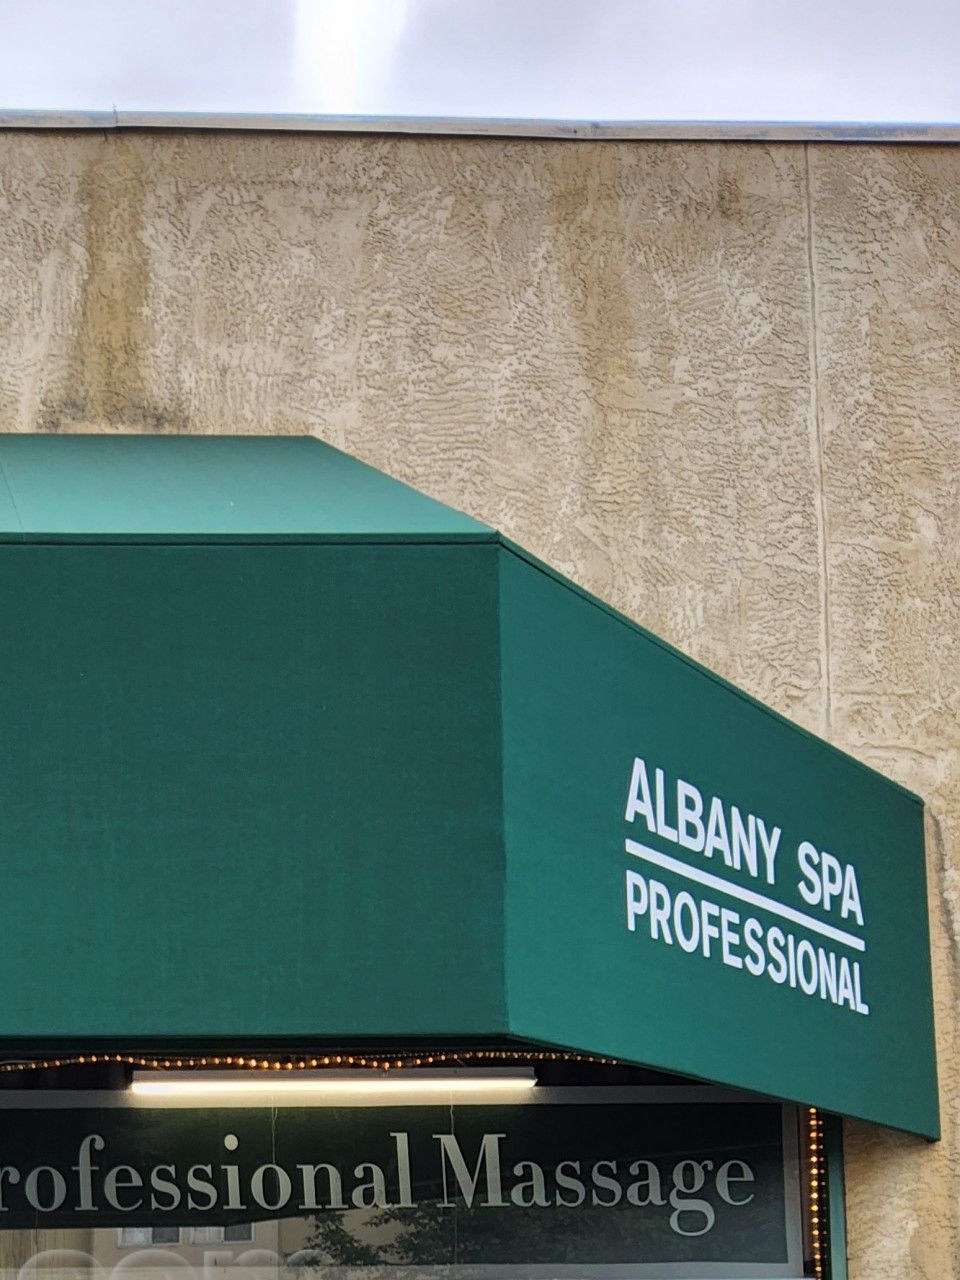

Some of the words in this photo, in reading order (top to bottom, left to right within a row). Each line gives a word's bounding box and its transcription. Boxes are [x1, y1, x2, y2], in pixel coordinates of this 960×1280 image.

[624, 756, 782, 885] ALBANY
[797, 840, 865, 926] SPA
[625, 869, 870, 1016] PROFESSIONAL
[433, 1132, 755, 1237] Massage
